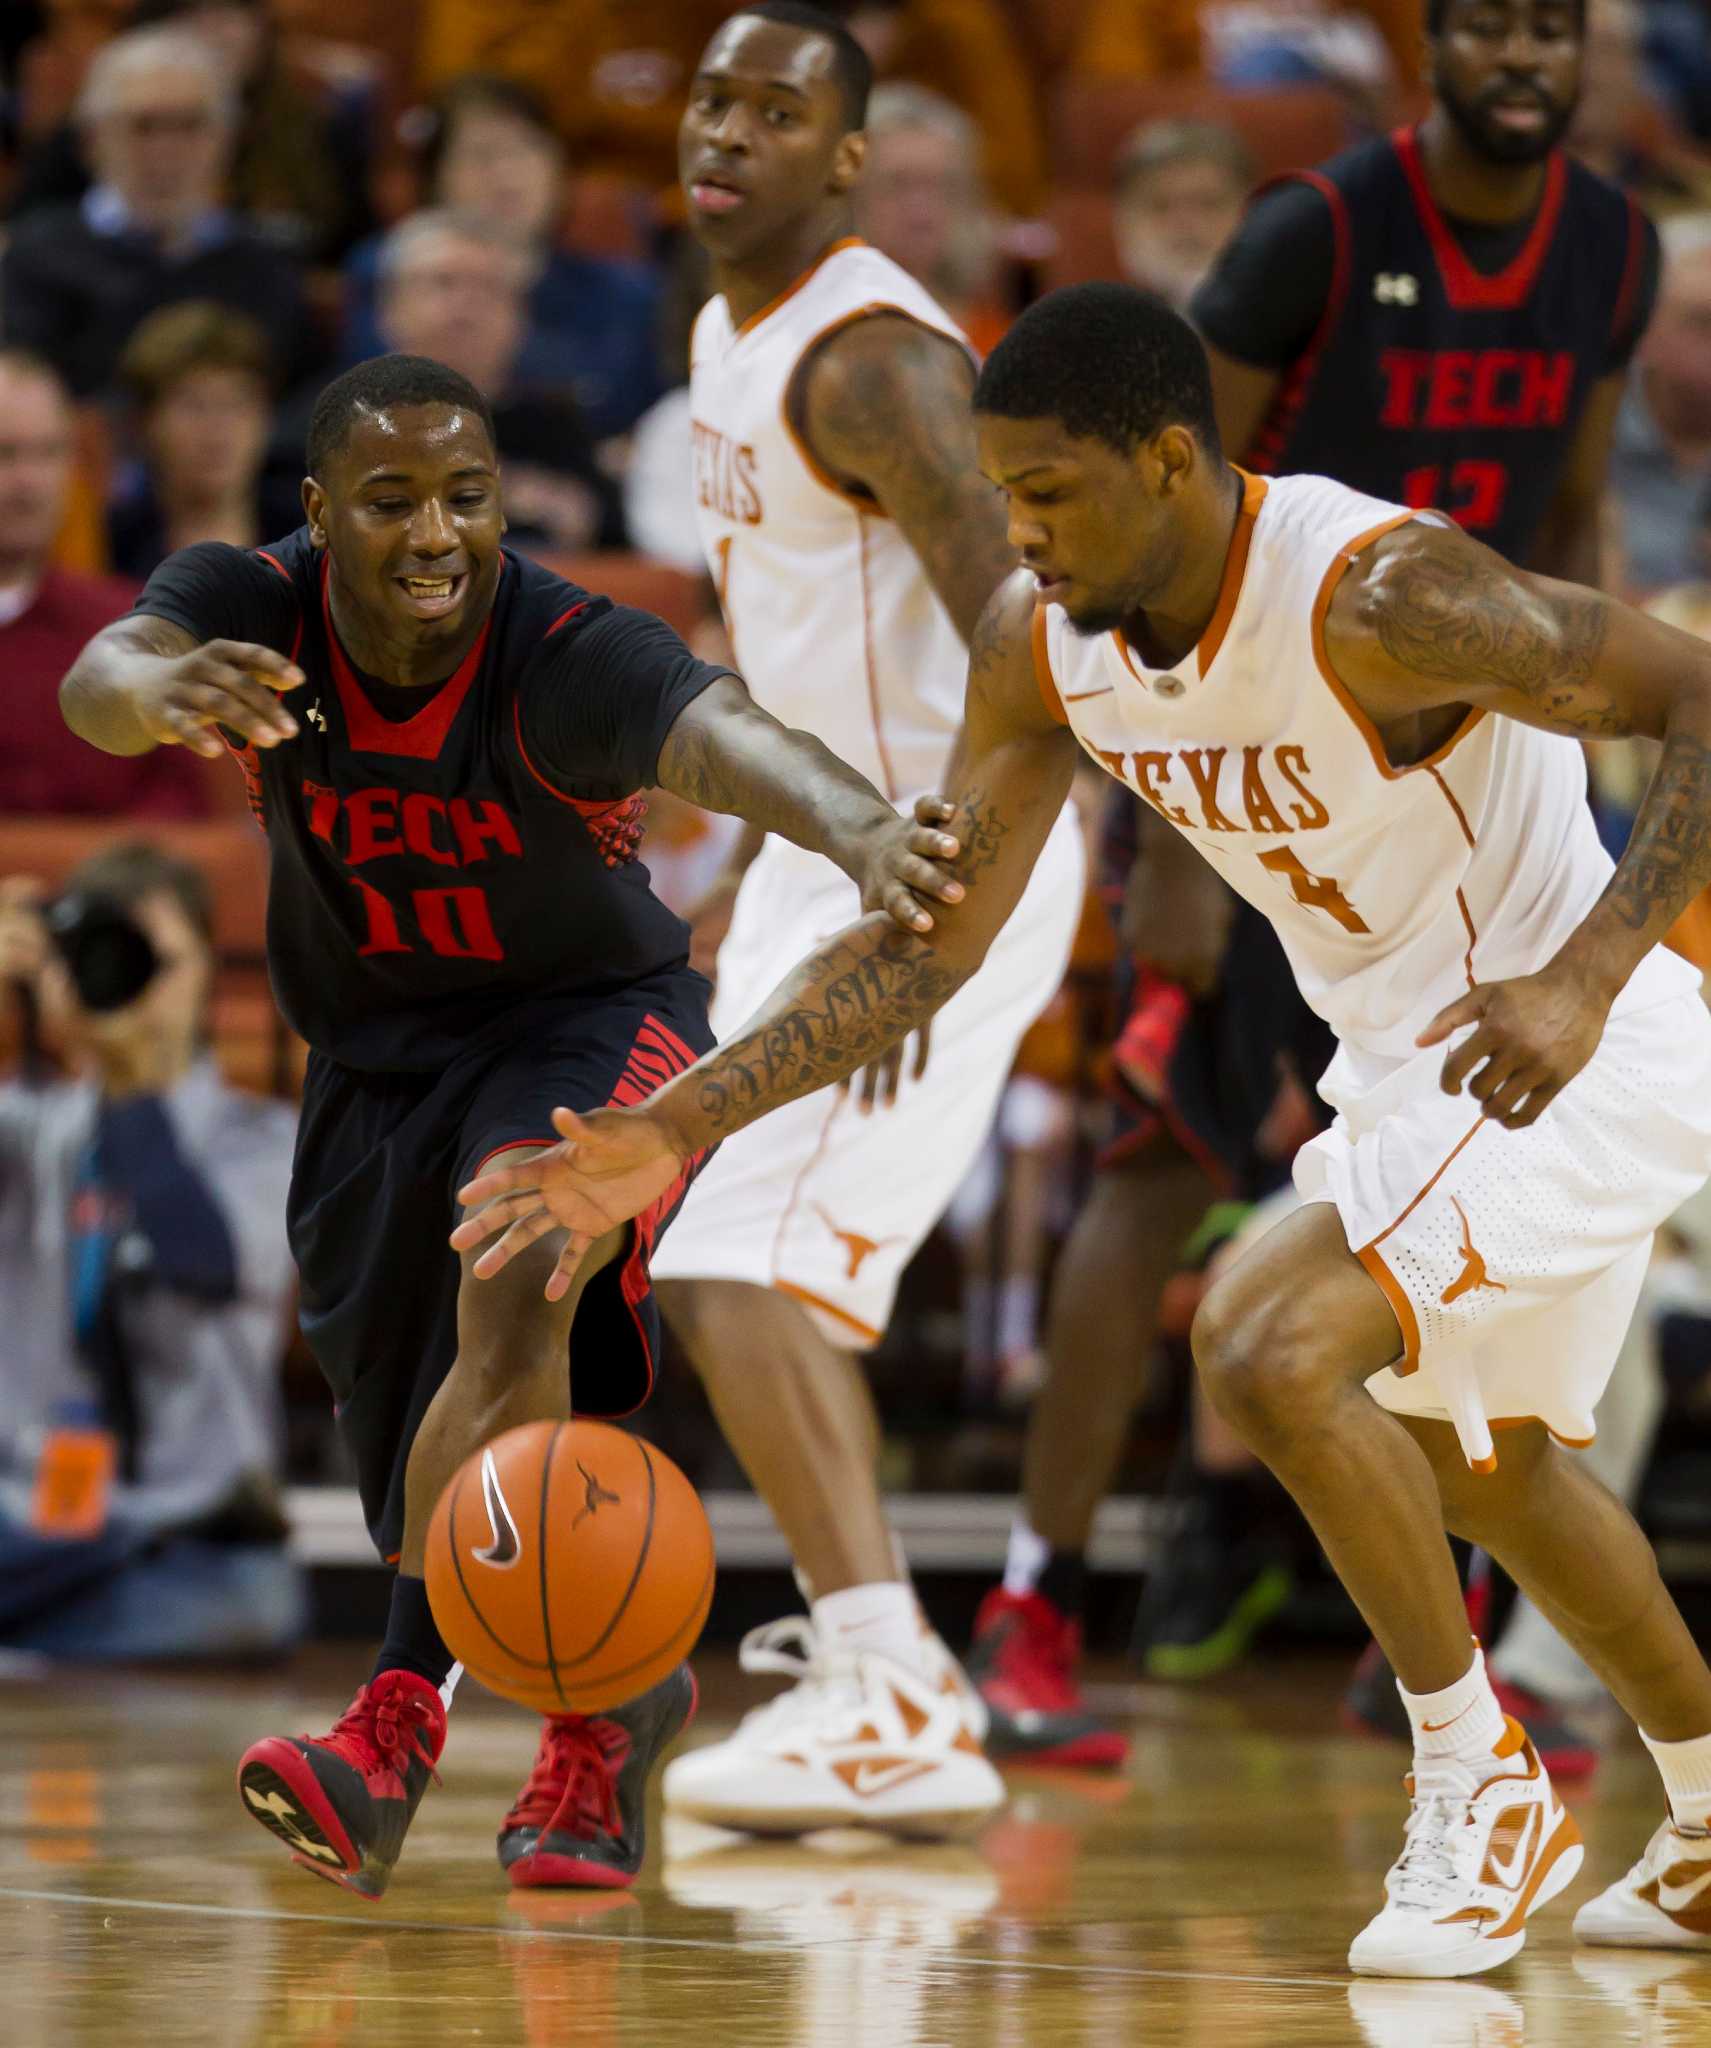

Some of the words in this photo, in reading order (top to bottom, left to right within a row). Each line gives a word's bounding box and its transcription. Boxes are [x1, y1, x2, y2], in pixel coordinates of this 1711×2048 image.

[1378, 347, 1575, 430] TECH
[690, 417, 764, 528] EXAS
[302, 780, 525, 869] TECH
[349, 877, 505, 963] 10
